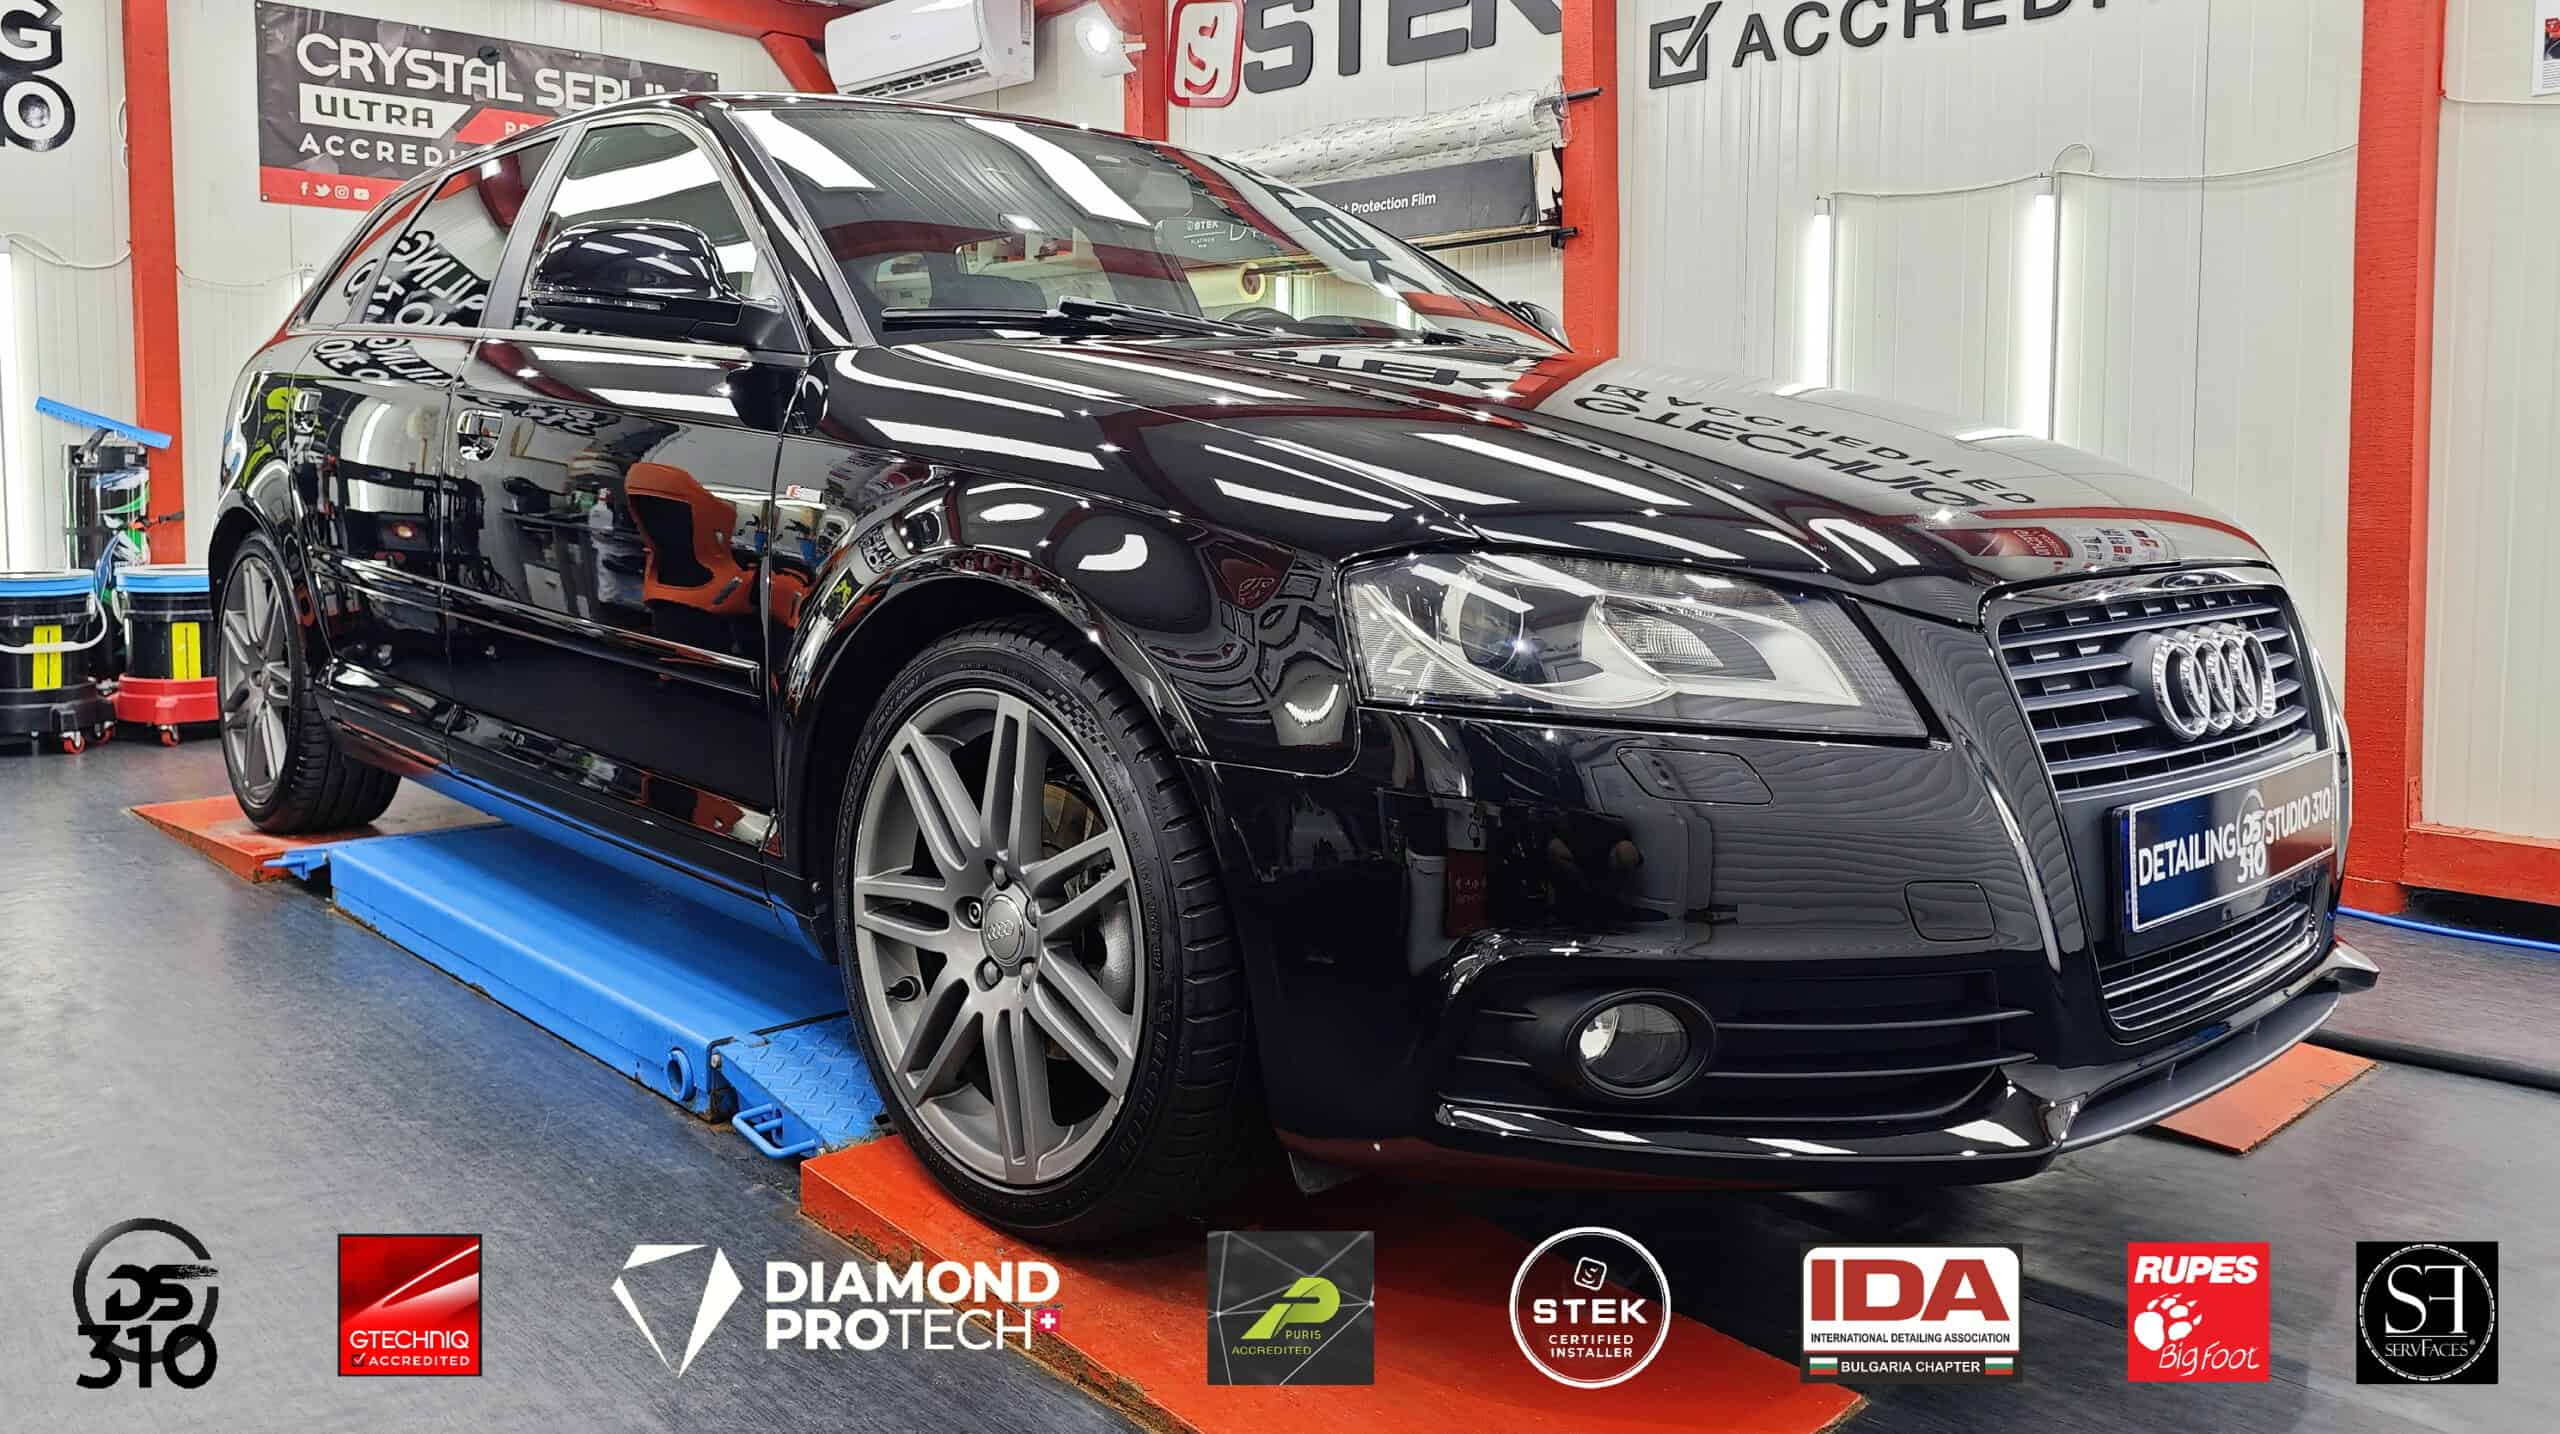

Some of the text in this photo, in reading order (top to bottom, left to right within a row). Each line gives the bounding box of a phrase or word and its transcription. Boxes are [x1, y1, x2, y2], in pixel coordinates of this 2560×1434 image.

[296, 32, 689, 110] CRYSTAL SER
[315, 93, 433, 129] ULTRA
[1351, 196, 1409, 214] Protection
[1411, 192, 1437, 206] Film
[2138, 822, 2236, 886] DETAILING
[2265, 796, 2310, 844] STUDIO
[2312, 787, 2331, 823] 310
[2237, 845, 2266, 883] 310
